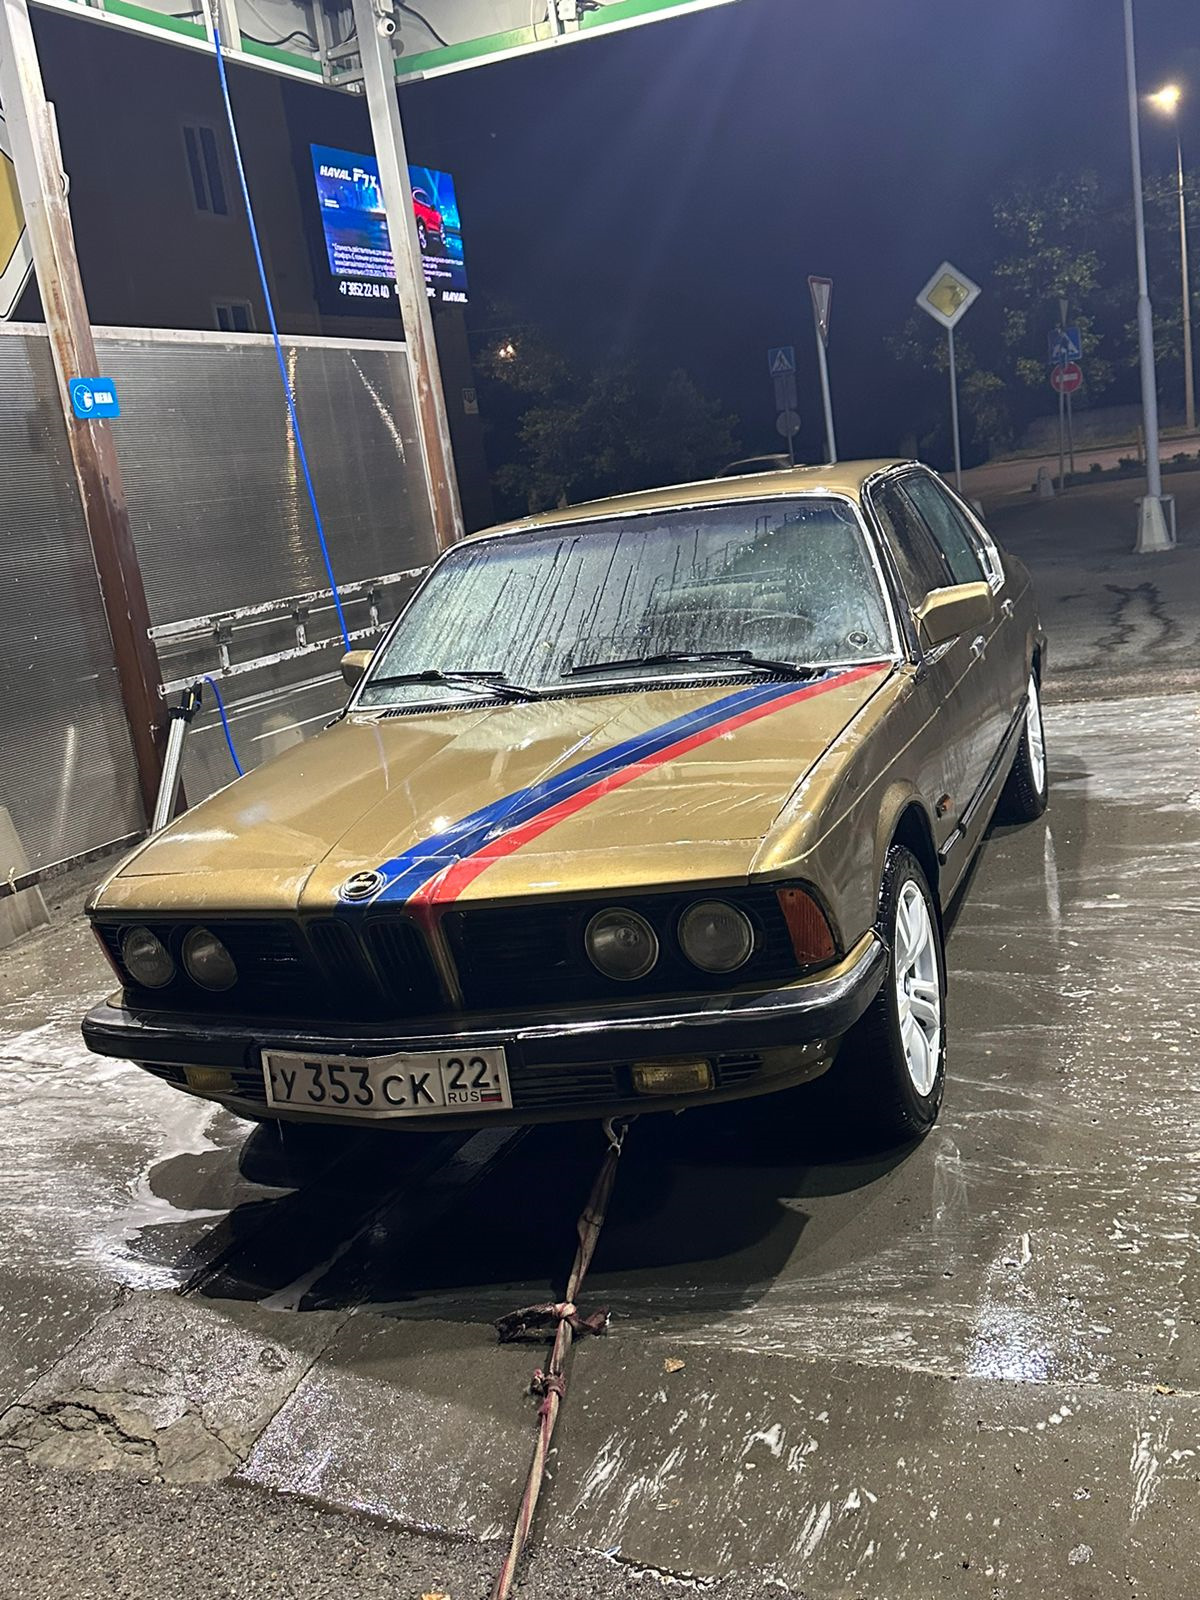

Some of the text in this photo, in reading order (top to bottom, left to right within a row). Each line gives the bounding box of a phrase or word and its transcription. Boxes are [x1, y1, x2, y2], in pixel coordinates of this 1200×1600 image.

[320, 165, 352, 181] HAVAL
[304, 1062, 374, 1106] 353
[447, 1057, 490, 1090] 22
[448, 1090, 480, 1104] RUS
